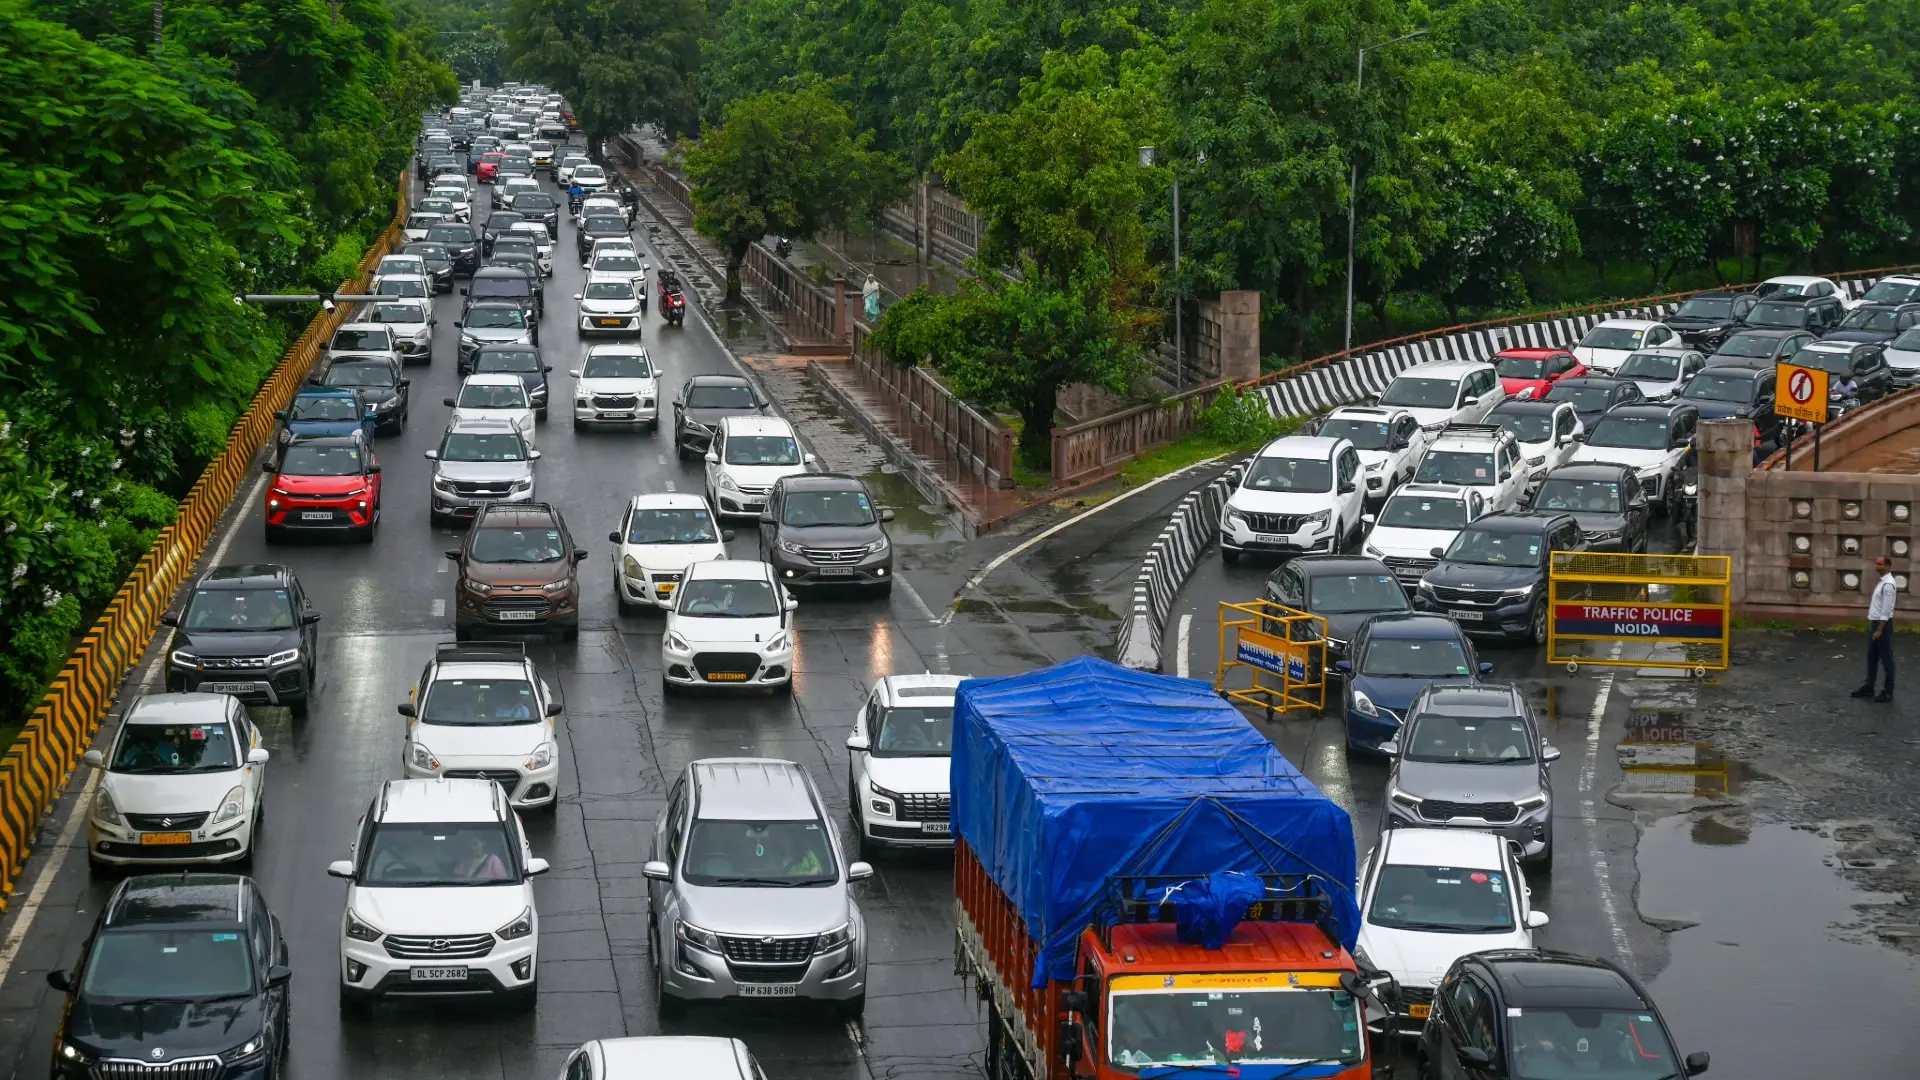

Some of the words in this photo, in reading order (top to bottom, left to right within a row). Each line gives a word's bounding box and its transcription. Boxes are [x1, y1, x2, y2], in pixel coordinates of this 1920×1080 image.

[1583, 606, 1639, 620] TRAFFIC
[1643, 607, 1693, 622] POLICE
[1614, 623, 1660, 635] NOIDA
[1240, 639, 1274, 660] यातायात
[417, 969, 427, 979] DL
[430, 969, 445, 978] 5CP
[446, 969, 466, 978] 2682
[745, 986, 755, 995] HP
